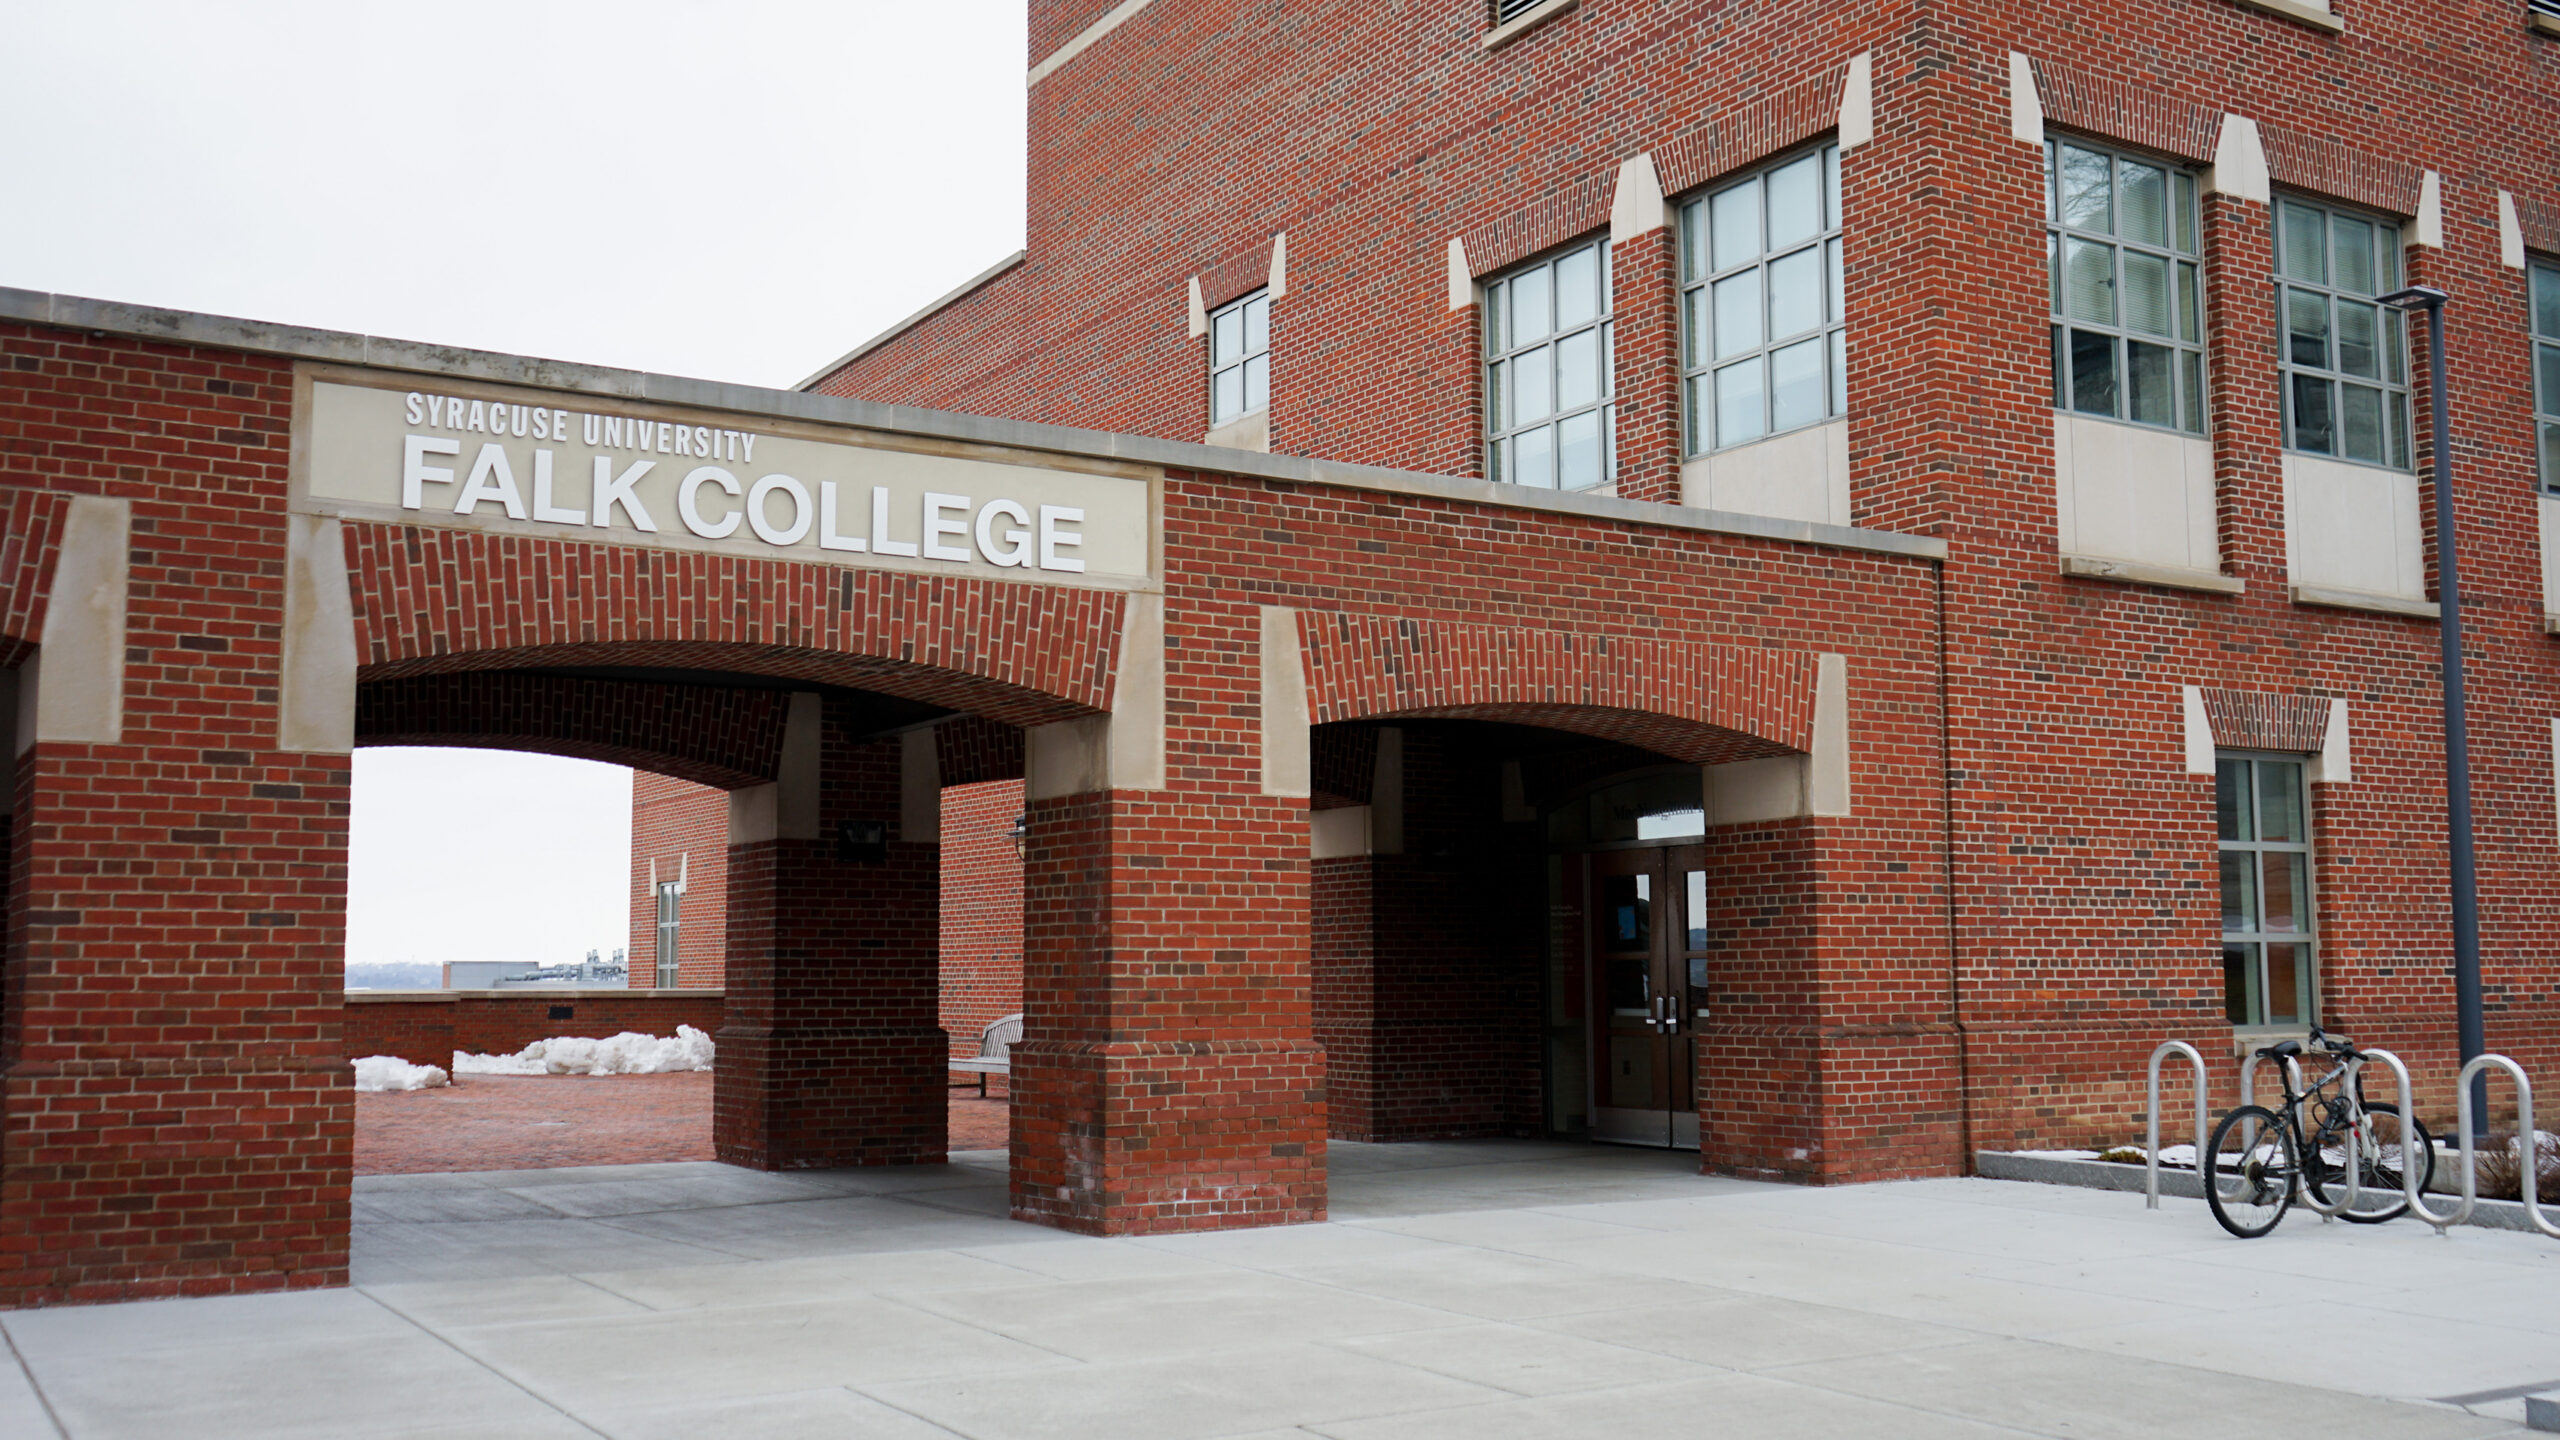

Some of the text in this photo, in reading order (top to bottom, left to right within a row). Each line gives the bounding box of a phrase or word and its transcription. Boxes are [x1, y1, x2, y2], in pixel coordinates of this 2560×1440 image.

[405, 391, 757, 463] SYRACUSE UNIVERSITY
[402, 433, 1086, 573] FALK COLLEGE
